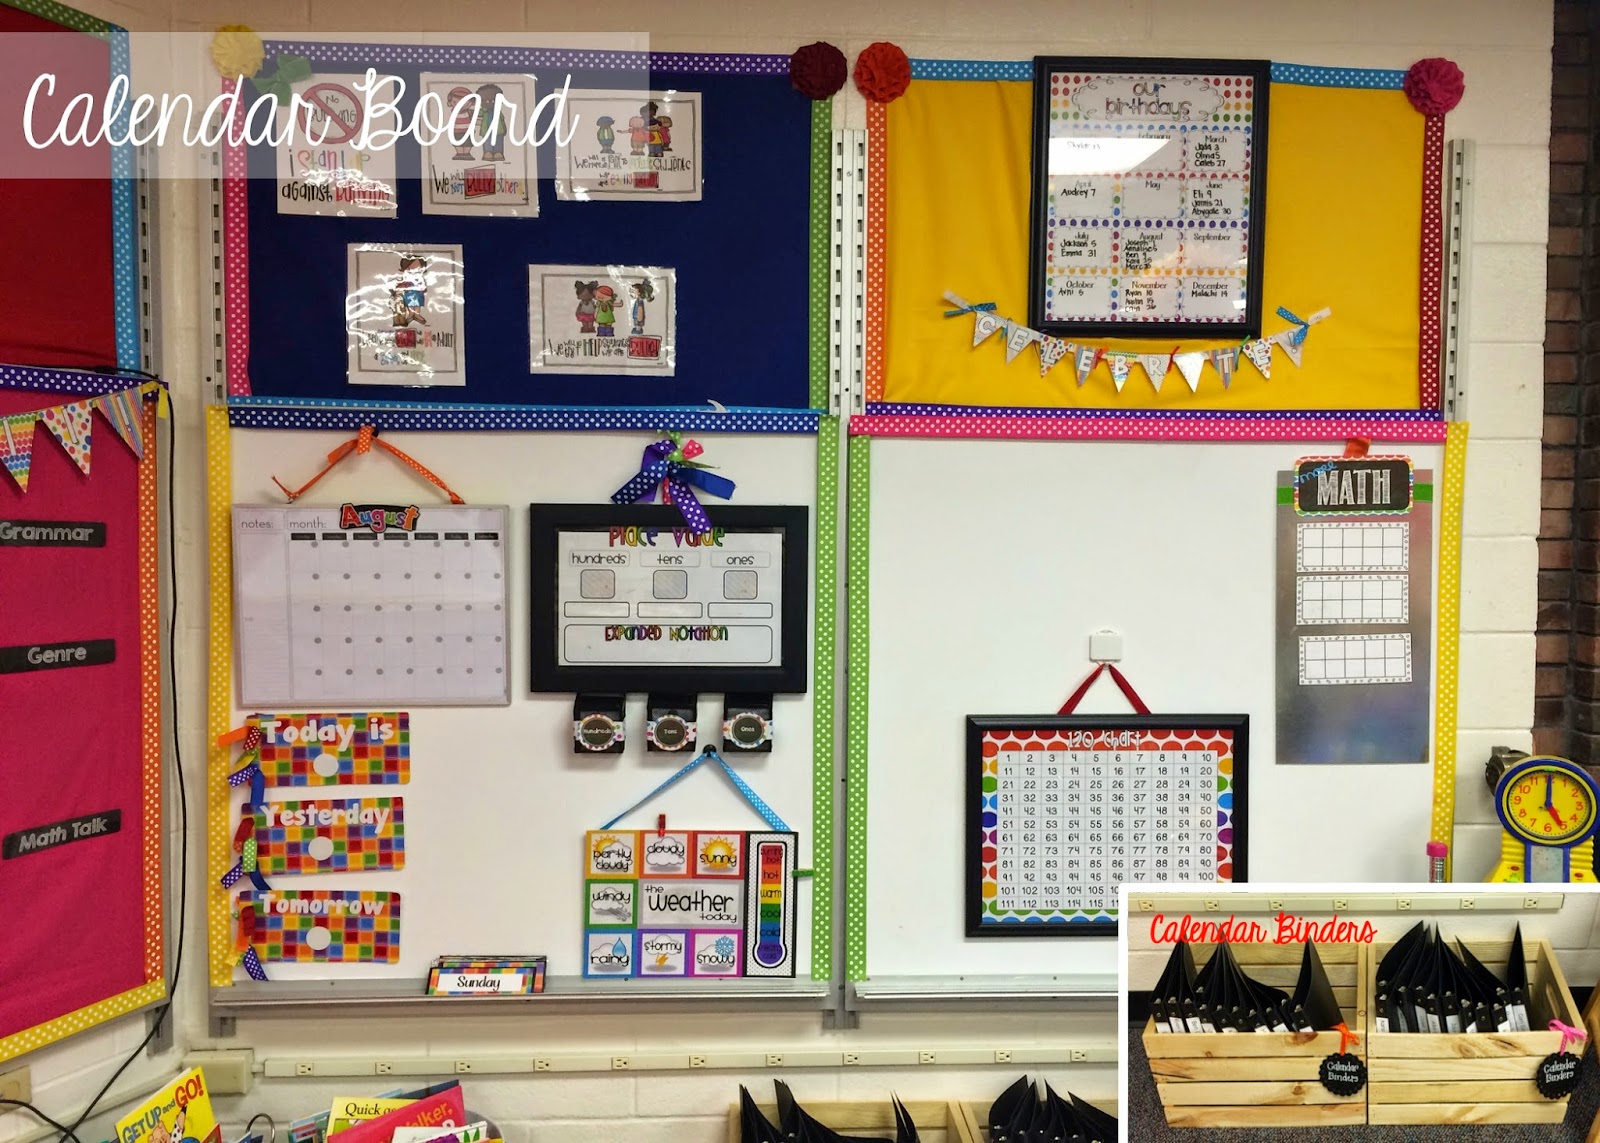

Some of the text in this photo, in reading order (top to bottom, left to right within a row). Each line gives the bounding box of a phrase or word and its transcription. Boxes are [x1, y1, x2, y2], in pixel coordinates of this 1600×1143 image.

[1132, 82, 1166, 98] our
[1105, 97, 1192, 121] birthdays
[1205, 135, 1227, 143] March
[1194, 159, 1215, 167] Caleb
[432, 164, 450, 195] We
[1075, 180, 1092, 189] April
[1145, 181, 1161, 190] May
[1206, 181, 1223, 189] June
[1060, 188, 1096, 198] Audrey 7
[1214, 199, 1223, 207] 21
[1075, 232, 1089, 241] July
[1139, 233, 1163, 242] August
[1193, 233, 1231, 243] September
[1060, 239, 1088, 248] Jackson
[1061, 249, 1097, 257] Emma 31
[1066, 280, 1095, 288] October
[1131, 281, 1168, 289] November
[1192, 281, 1229, 289] December
[1125, 288, 1142, 297] Ryan
[978, 316, 1298, 377] CELEBRTE!
[1316, 469, 1392, 507] MATH
[340, 503, 421, 533] August
[241, 519, 327, 529] notes: month:
[0, 523, 94, 544] Grammar
[609, 526, 659, 547] Place
[571, 552, 627, 565] hundreds
[657, 554, 684, 565] tens
[726, 555, 755, 565] ones
[27, 645, 88, 665] Genre
[260, 717, 394, 751] Today is
[1067, 730, 1142, 748] 120 Chart
[1006, 753, 1212, 762] 1 2 3 4 5 6 7 8 9 10
[1005, 766, 1213, 775] 11 12 13 14 15 16 17 18 19 20
[1530, 776, 1538, 785] 11
[1562, 779, 1567, 787] 1
[1519, 784, 1531, 794] 10
[1571, 788, 1579, 797] 2
[1513, 795, 1522, 805] 9
[1576, 801, 1584, 811] 3
[1518, 808, 1527, 818] 8
[260, 803, 391, 834] Yesterday
[1530, 818, 1537, 827] 7
[1569, 814, 1578, 823] 4
[1544, 823, 1552, 832] 6
[18, 817, 108, 853] Math Talk
[646, 842, 685, 856] cloudy
[592, 849, 632, 862] partly
[699, 853, 737, 867] sunny
[596, 859, 630, 872] cloudy
[763, 870, 779, 879] hot
[645, 885, 664, 893] the
[760, 889, 782, 898] warm
[592, 892, 631, 904] windy
[648, 890, 734, 913] weather
[258, 894, 385, 915] Tomorrow
[700, 911, 738, 924] today
[759, 928, 781, 937] cold
[644, 940, 682, 954] stormy
[591, 953, 630, 967] rainy
[697, 953, 736, 968] snowy
[457, 975, 501, 991] Sunday
[1327, 1061, 1360, 1073] Calendar
[1543, 1058, 1576, 1074] Calendar
[1328, 1072, 1359, 1083] Binders
[1545, 1069, 1574, 1084] Binders
[122, 1074, 204, 1143] GET UP and GO!
[345, 1102, 381, 1117] Quick
